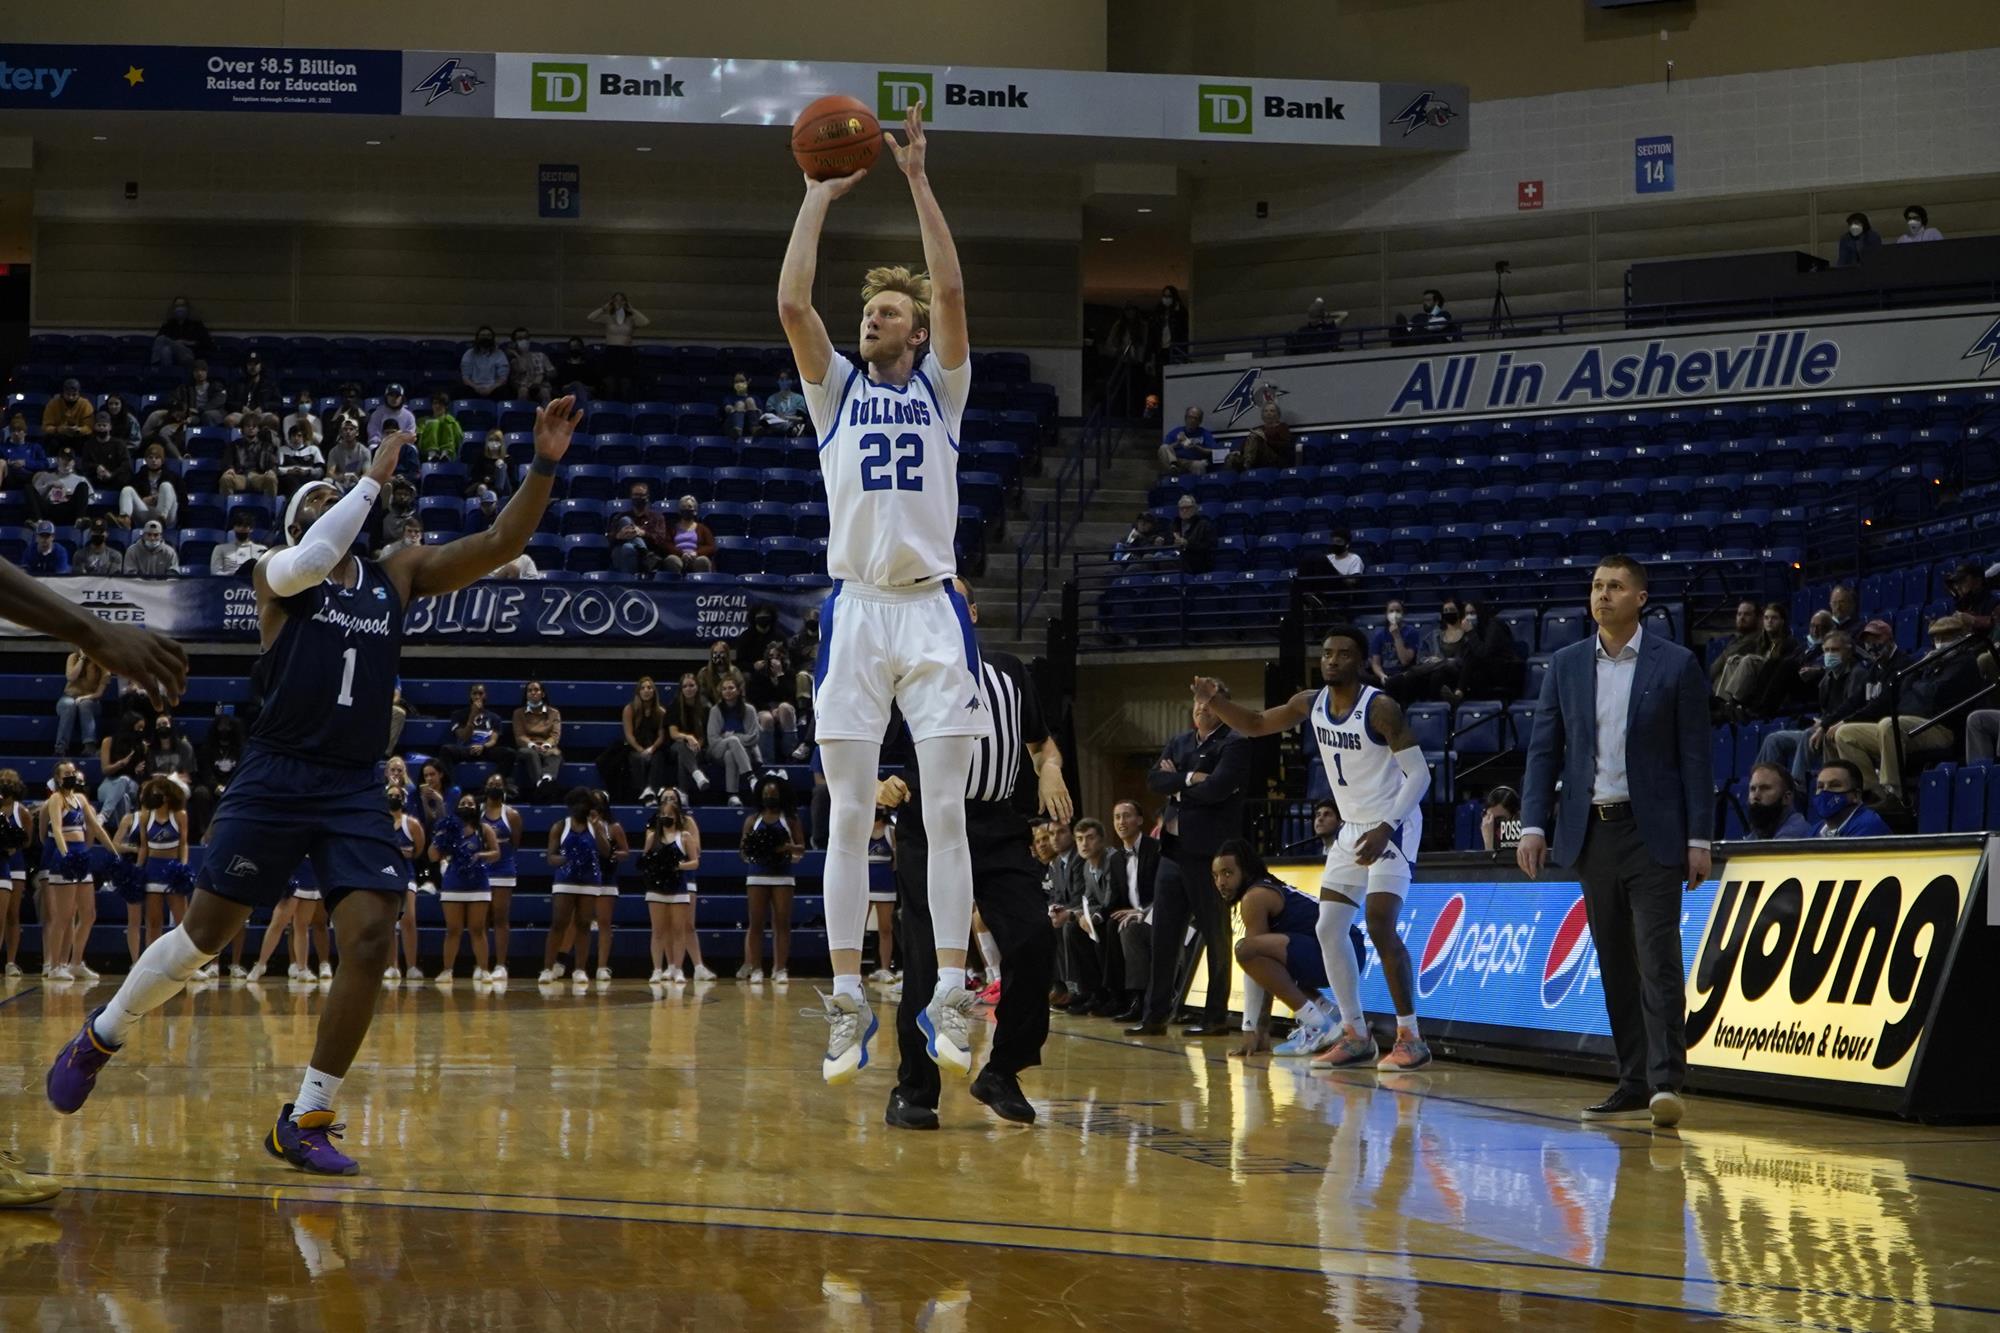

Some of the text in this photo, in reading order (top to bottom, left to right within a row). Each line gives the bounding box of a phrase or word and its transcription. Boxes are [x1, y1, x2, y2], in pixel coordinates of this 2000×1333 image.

[207, 56, 358, 76] Over $8.5 Billion
[206, 76, 358, 92] Raised for Education
[537, 71, 684, 103] TD Bank
[882, 81, 1029, 112] TD Bank
[1203, 94, 1345, 124] TD Bank
[1637, 143, 1672, 157] SECTION
[1643, 160, 1665, 184] 14
[548, 187, 570, 209] 13
[1386, 329, 1841, 417] All in Asheville
[850, 397, 931, 427] BULLDOGS
[859, 433, 929, 492] 22
[82, 590, 123, 600] THE
[224, 588, 257, 600] OFFIC
[696, 595, 747, 607] OFFICIAL
[311, 596, 391, 638] Longwood
[403, 586, 660, 636] BLUE ZOO
[697, 611, 749, 623] STUDENT
[337, 647, 357, 707] 1
[1316, 726, 1361, 750] BULLDOGS
[1334, 753, 1348, 786] 1
[1448, 911, 1541, 987] pepsi
[1686, 874, 1960, 1070] young
[1714, 1017, 1874, 1061] transportation & tours
